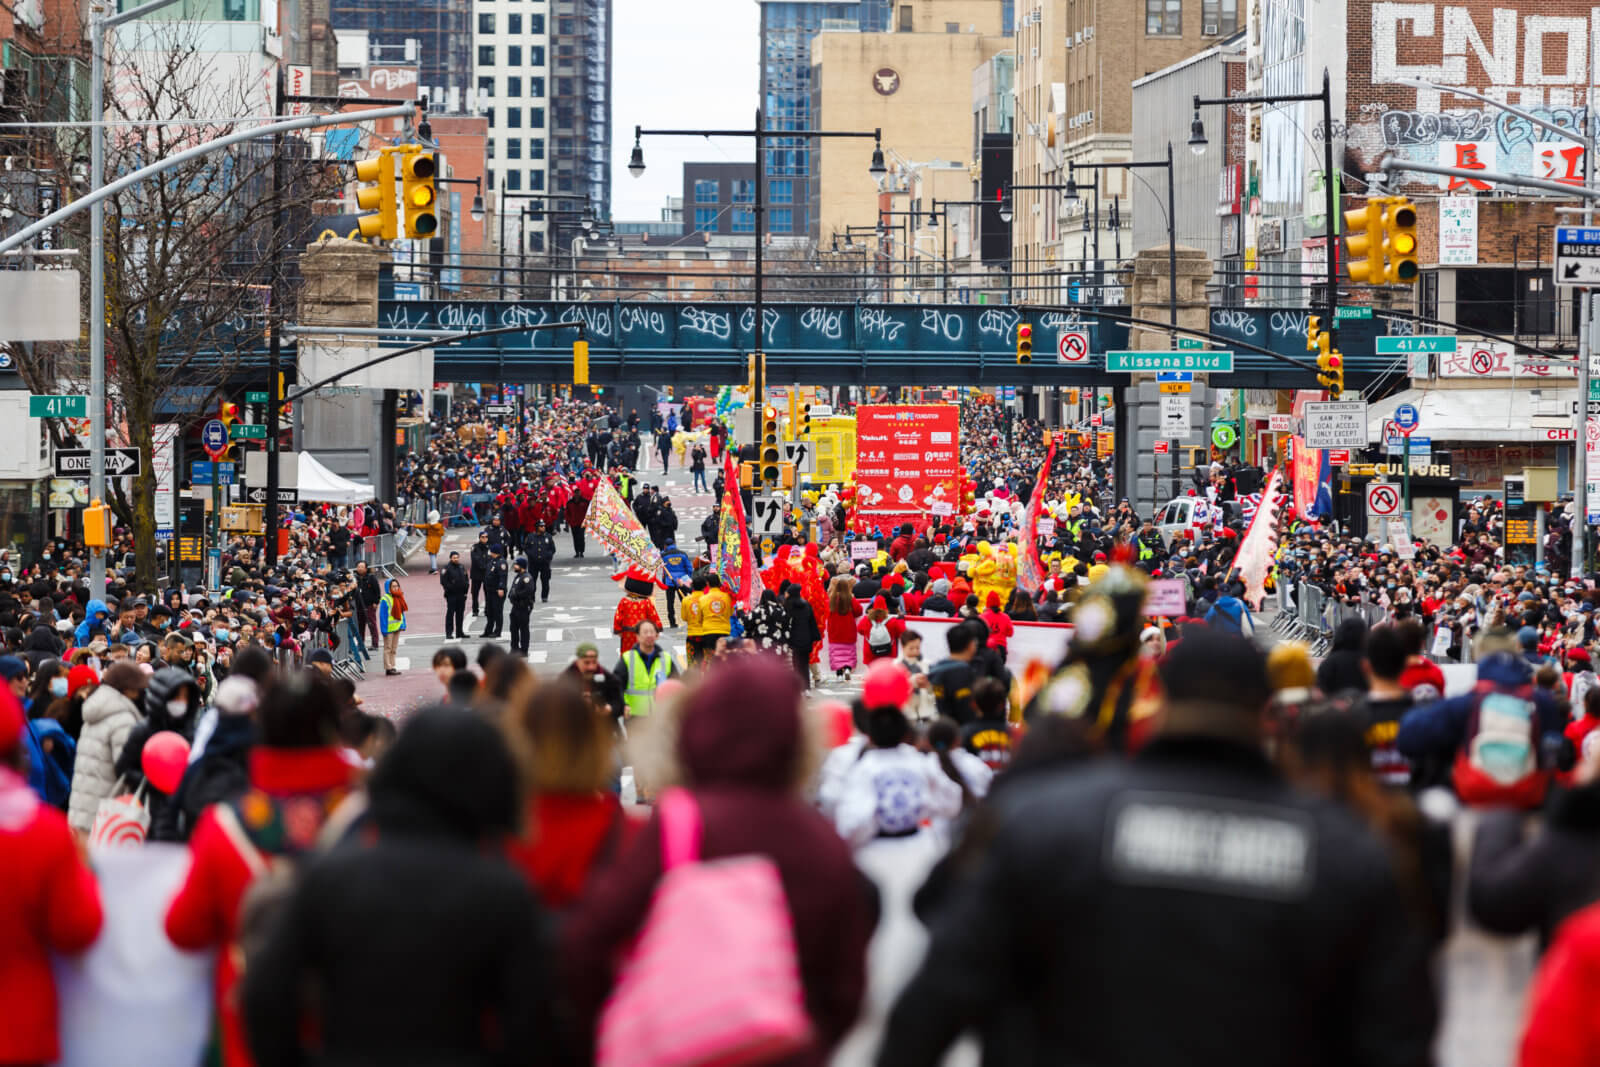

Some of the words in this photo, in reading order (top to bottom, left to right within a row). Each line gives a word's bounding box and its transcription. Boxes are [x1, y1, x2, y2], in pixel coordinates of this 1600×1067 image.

[1563, 245, 1600, 255] BUSES
[1338, 306, 1361, 318] Kissena
[1397, 340, 1412, 350] 41
[1418, 340, 1437, 350] Av
[1119, 356, 1181, 367] Kissena
[1185, 356, 1220, 367] Blvd
[251, 393, 259, 401] 41
[46, 399, 62, 414] 41
[65, 398, 76, 408] Rd
[238, 427, 248, 436] 41
[1334, 430, 1357, 438] EXCEPT
[67, 458, 90, 469] ONE
[104, 457, 127, 468] WAY
[1374, 462, 1450, 477] CULTURE
[254, 491, 267, 499] ON
